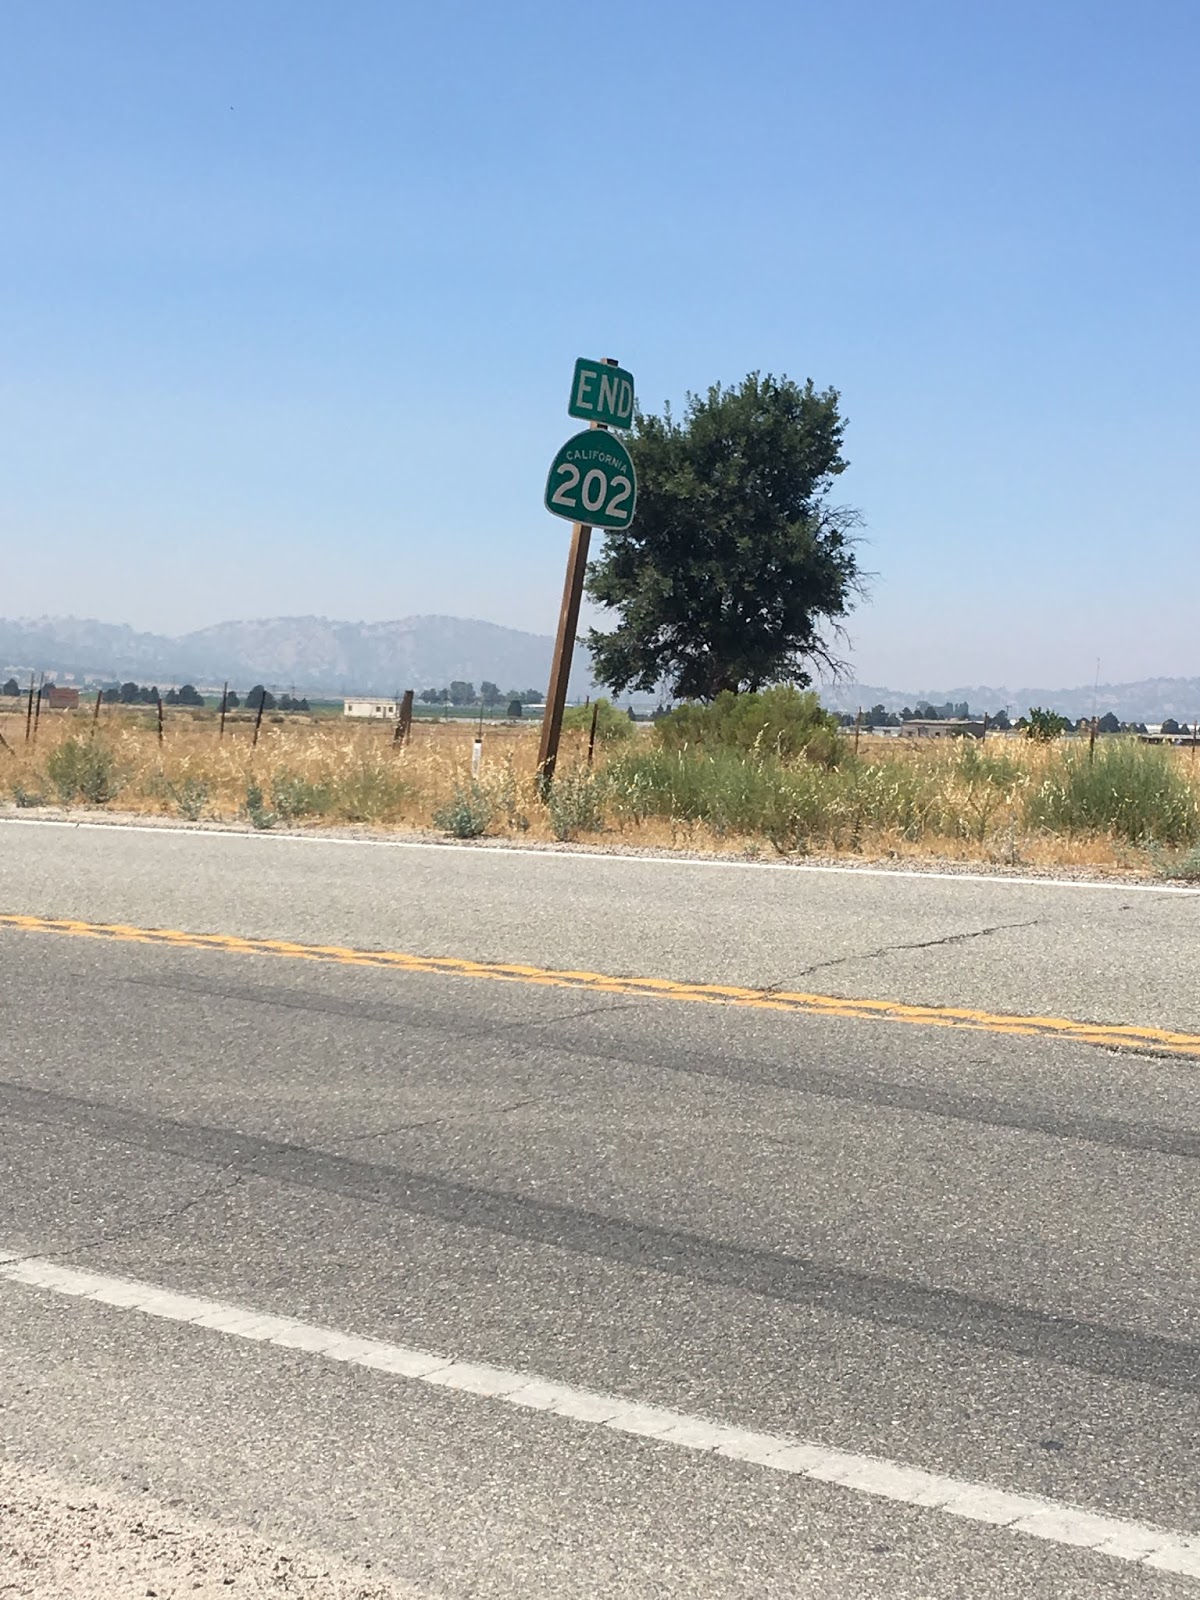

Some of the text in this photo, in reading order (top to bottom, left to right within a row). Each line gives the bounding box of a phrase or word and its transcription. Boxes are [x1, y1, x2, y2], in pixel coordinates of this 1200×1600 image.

[576, 369, 632, 419] END
[566, 450, 628, 473] CALIFORNIA
[551, 463, 631, 519] 202
